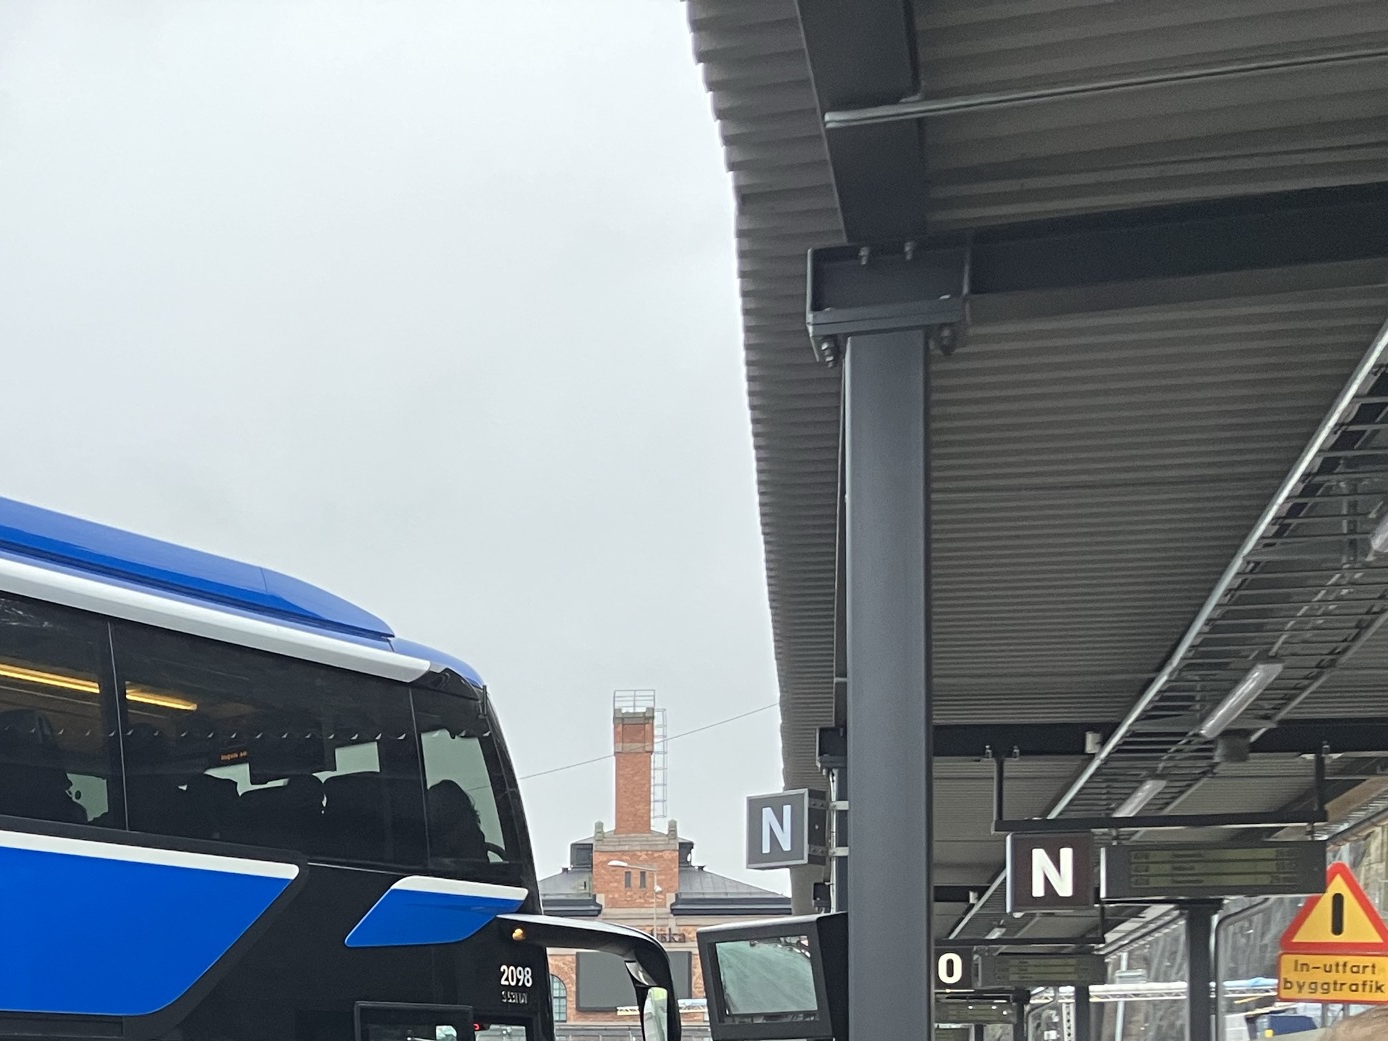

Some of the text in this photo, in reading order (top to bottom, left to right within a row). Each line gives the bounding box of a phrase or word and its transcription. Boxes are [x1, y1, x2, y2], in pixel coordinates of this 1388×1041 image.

[762, 804, 792, 854] N
[1031, 847, 1074, 898] N
[500, 965, 533, 987] 2098
[1293, 959, 1376, 975] In-utfart
[1283, 977, 1386, 995] byggtrafik
